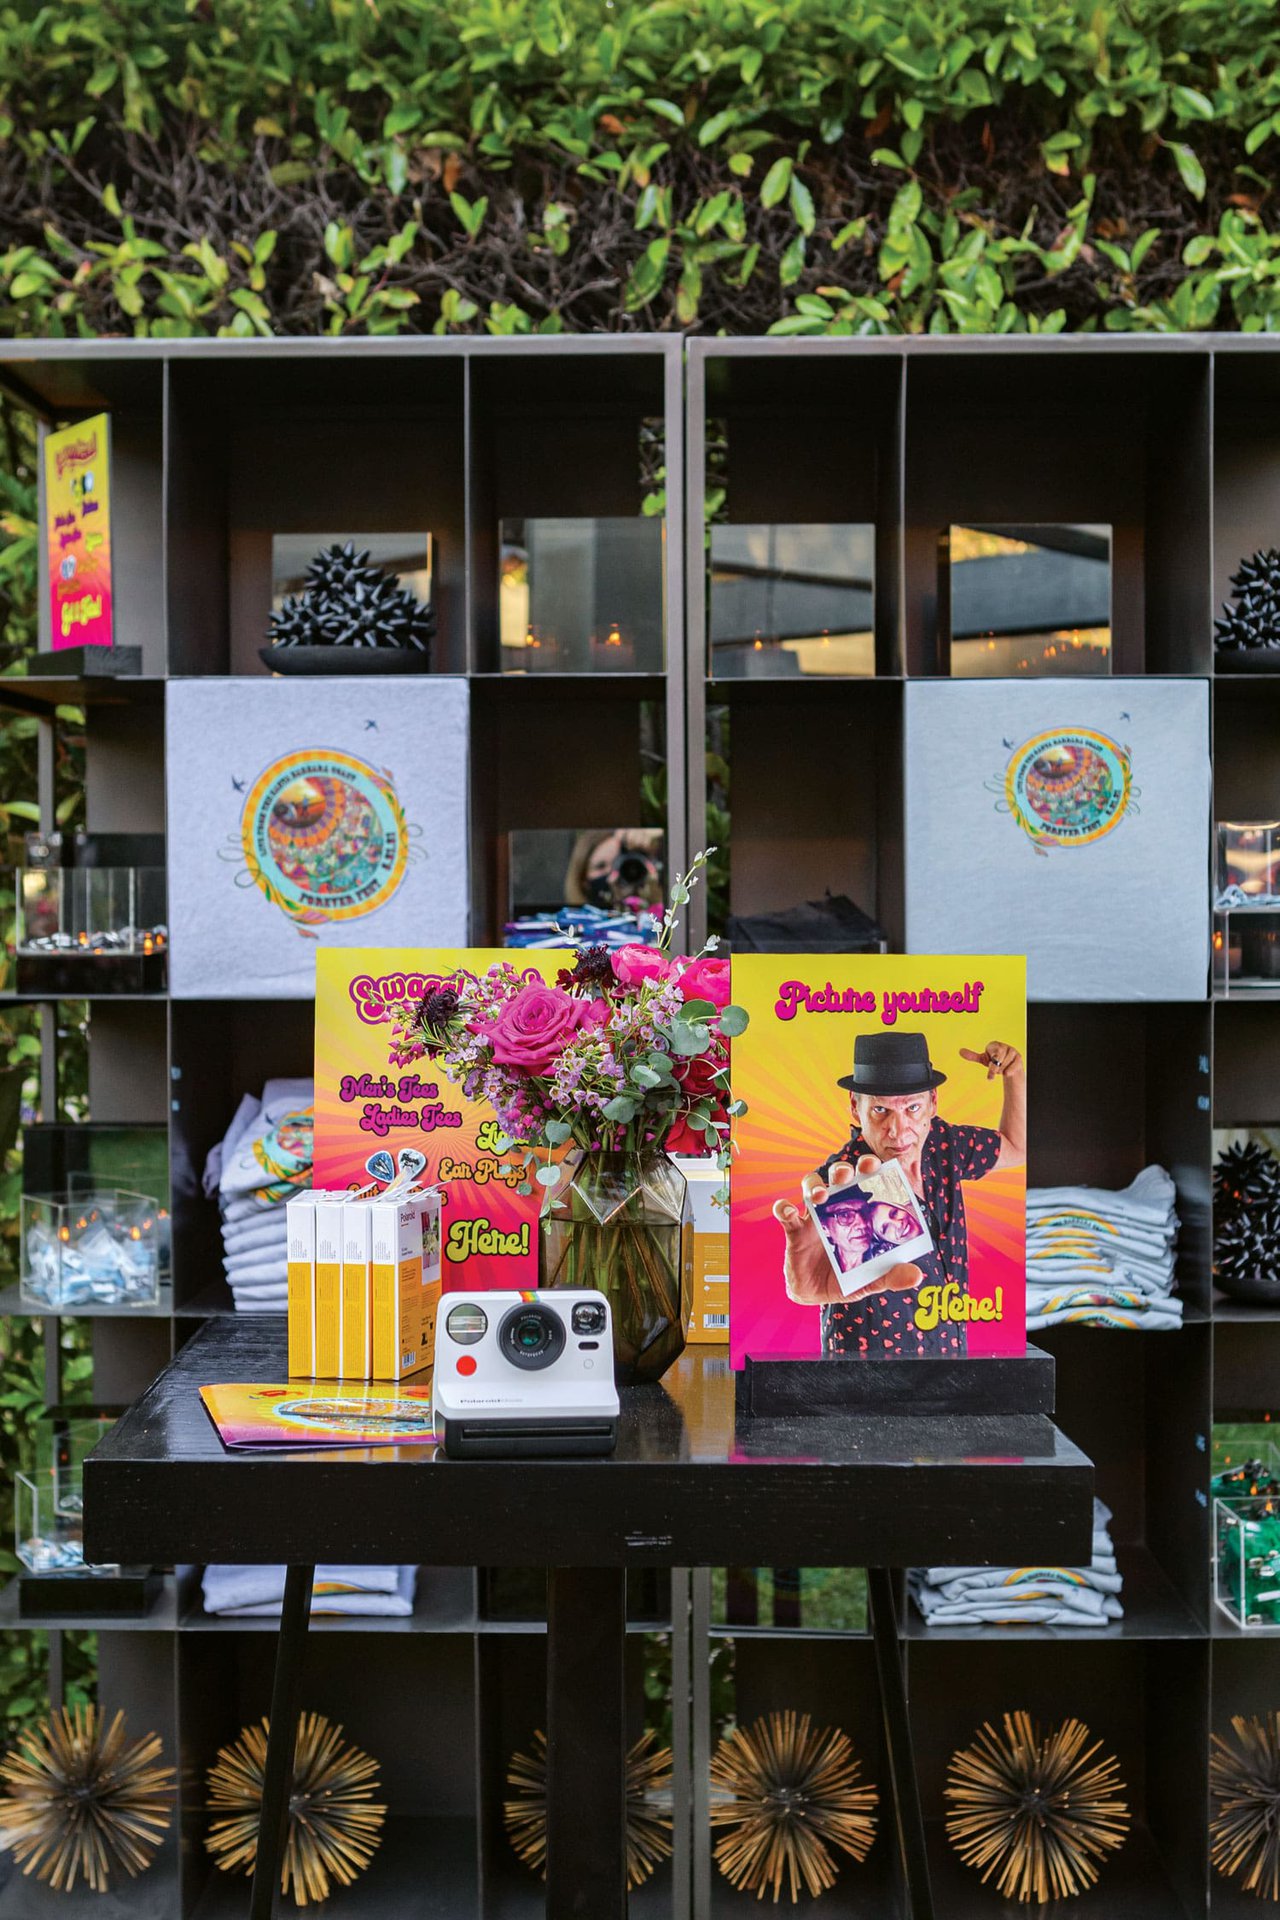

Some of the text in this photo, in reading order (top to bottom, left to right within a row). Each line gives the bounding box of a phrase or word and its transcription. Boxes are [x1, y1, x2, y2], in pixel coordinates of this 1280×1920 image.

[774, 980, 984, 1024] Picture yourself
[340, 1073, 439, 1103] Men's Tees
[359, 1102, 463, 1137] Ladies Tees
[438, 1157, 473, 1183] Ear
[474, 1158, 527, 1189] Plgs
[400, 1210, 416, 1222] Polaroid
[446, 1218, 530, 1262] Here!
[914, 1284, 1004, 1332] Here!
